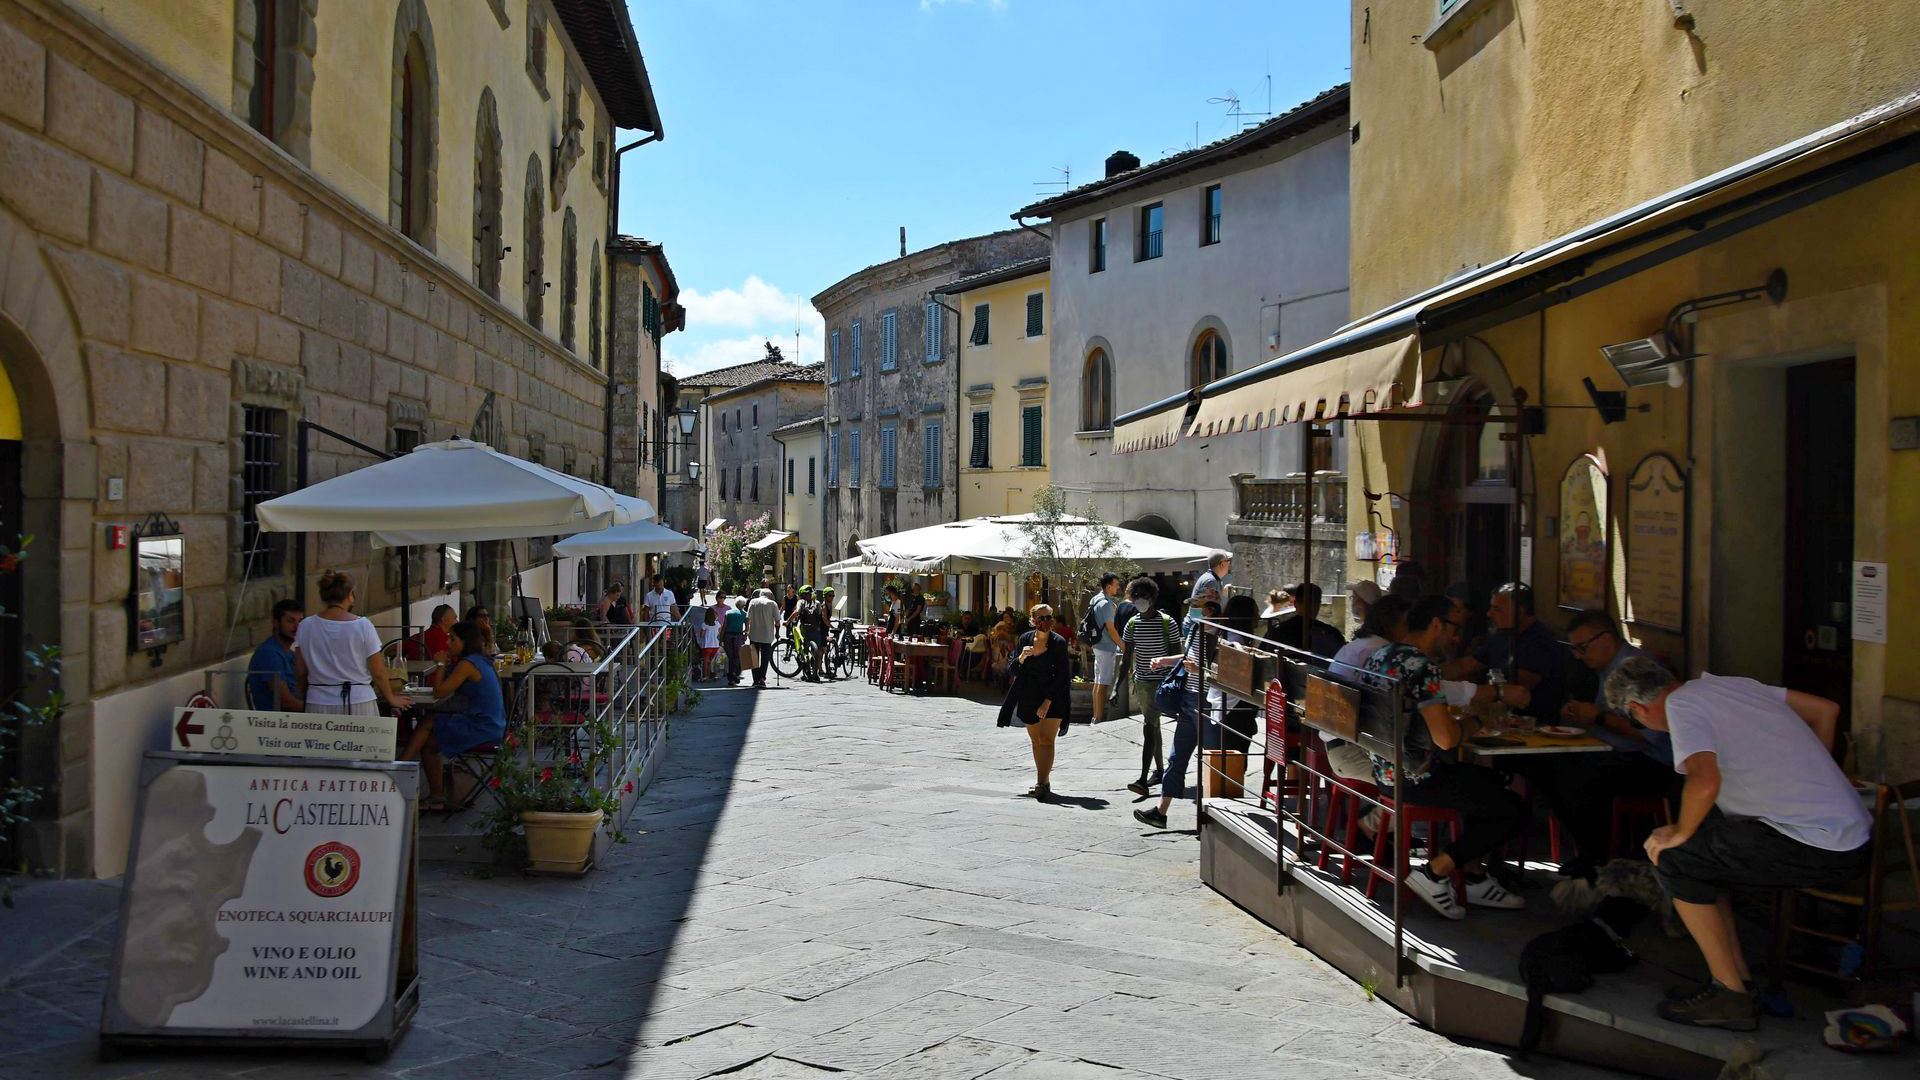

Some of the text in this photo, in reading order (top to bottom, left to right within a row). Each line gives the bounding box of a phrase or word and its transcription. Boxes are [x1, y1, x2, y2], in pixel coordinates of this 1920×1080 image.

[247, 716, 276, 728] Visita
[279, 718, 288, 729] la
[291, 721, 323, 731] nostra
[325, 721, 365, 733] Cantina
[258, 736, 282, 748] Visit
[284, 739, 301, 749] our
[304, 739, 331, 750] Wine
[333, 740, 364, 752] Cellar
[250, 779, 397, 793] ANTICA FATTORIA
[245, 798, 390, 835] LA CASTELLINA
[217, 910, 393, 924] ENOTECA SQUARCIALUPI
[252, 947, 356, 960] VINO E OLIO
[243, 966, 361, 980] WINE AND OIL
[252, 1015, 339, 1026] www.lacastellina.it
